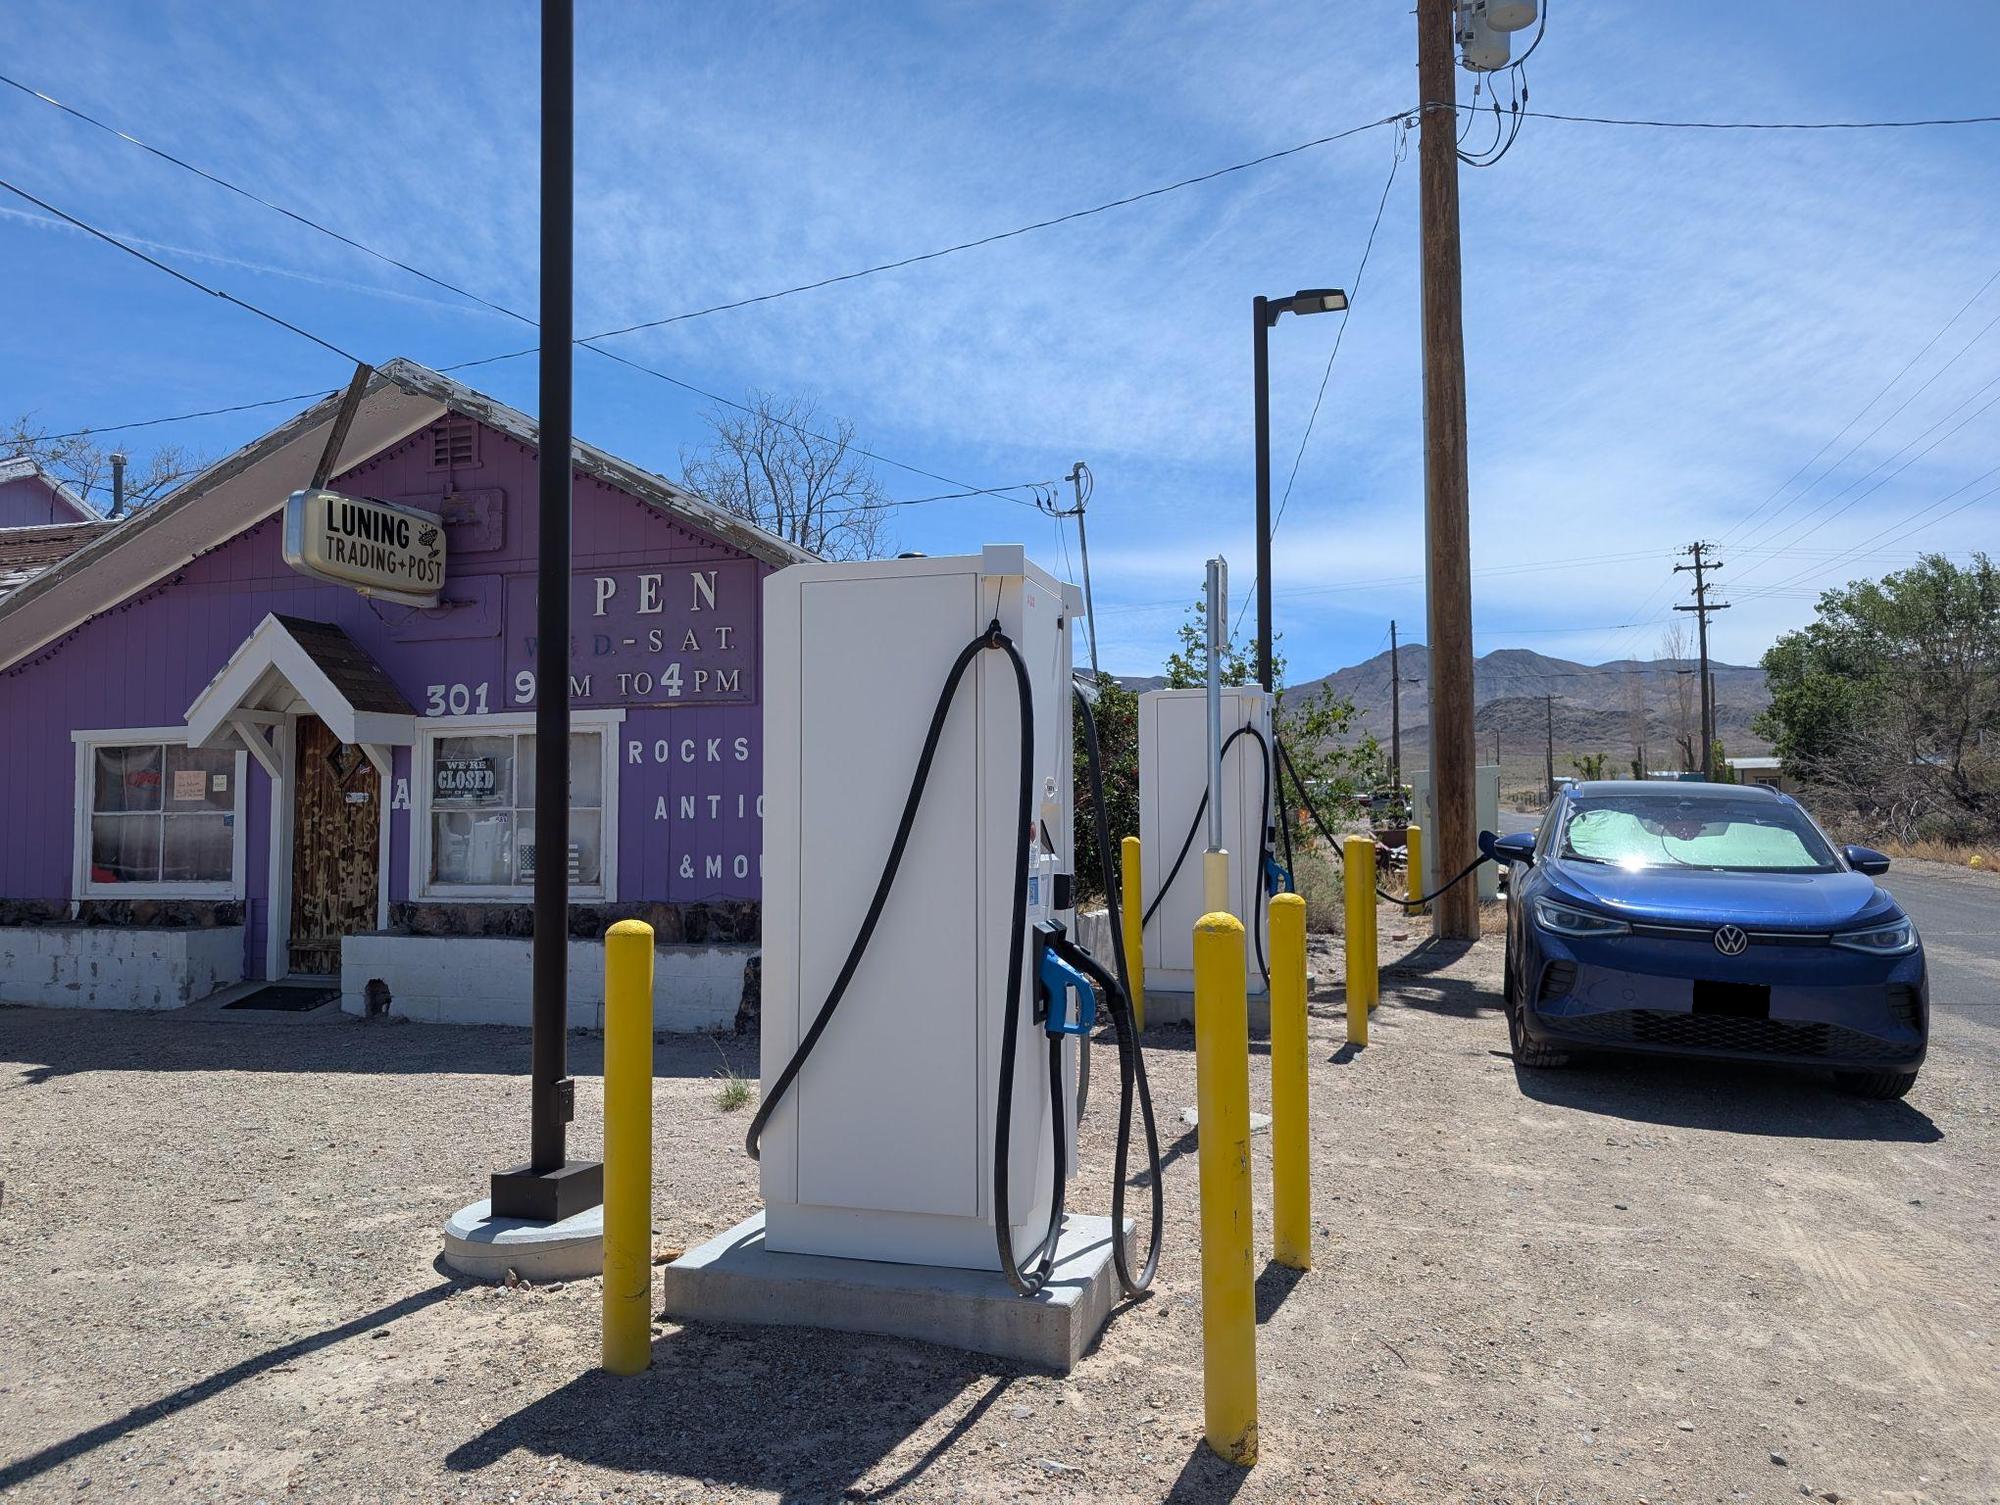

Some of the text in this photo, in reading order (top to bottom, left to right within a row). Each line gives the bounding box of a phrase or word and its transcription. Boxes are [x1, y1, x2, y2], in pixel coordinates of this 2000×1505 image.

[327, 500, 410, 549] LUNING
[408, 555, 442, 584] POST
[536, 571, 718, 616] PEN
[617, 672, 653, 696] TO
[660, 663, 684, 697] 4
[692, 669, 741, 693] PM
[425, 682, 488, 717] 301
[447, 761, 486, 769] WE'RE
[628, 737, 749, 764] ROCKS
[438, 770, 494, 789] CLOSED
